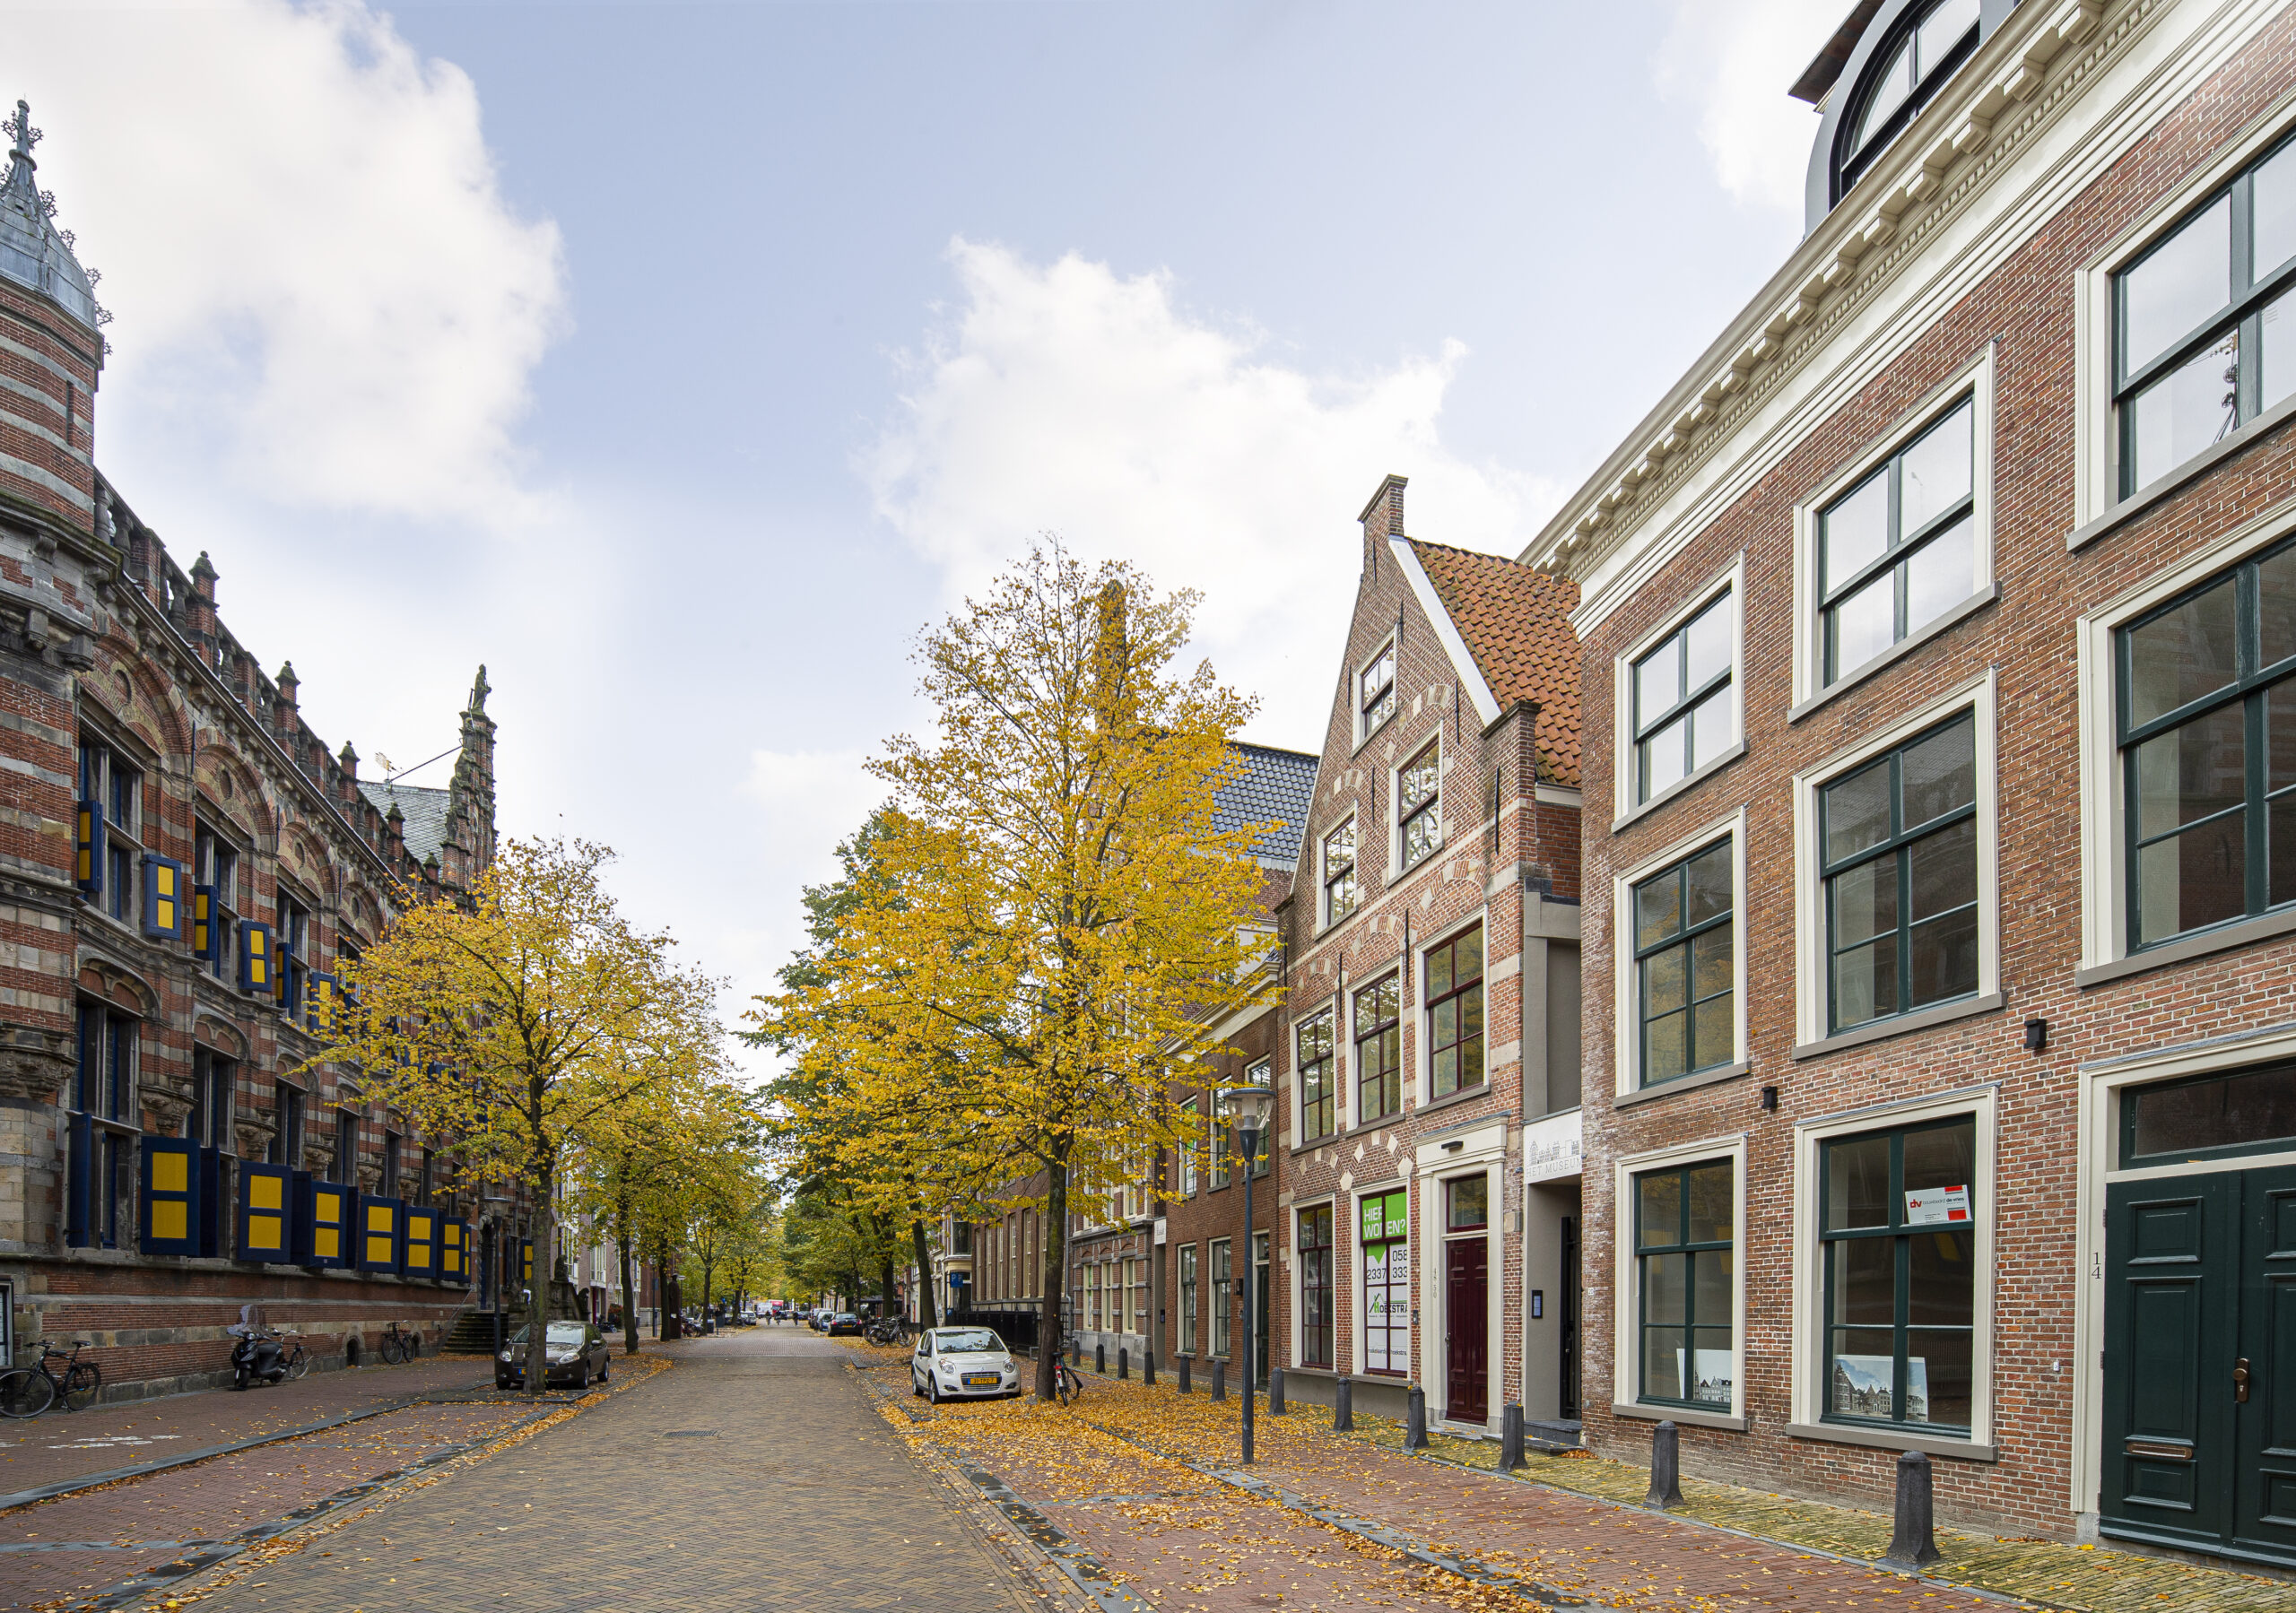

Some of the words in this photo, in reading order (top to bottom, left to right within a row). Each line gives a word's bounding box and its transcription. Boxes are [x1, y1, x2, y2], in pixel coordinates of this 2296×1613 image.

[1526, 1166, 1542, 1177] HET
[1909, 1198, 1923, 1209] dv
[1393, 1249, 1407, 1262] 058
[1367, 1268, 1387, 1279] 2337
[1393, 1266, 1407, 1279] 333
